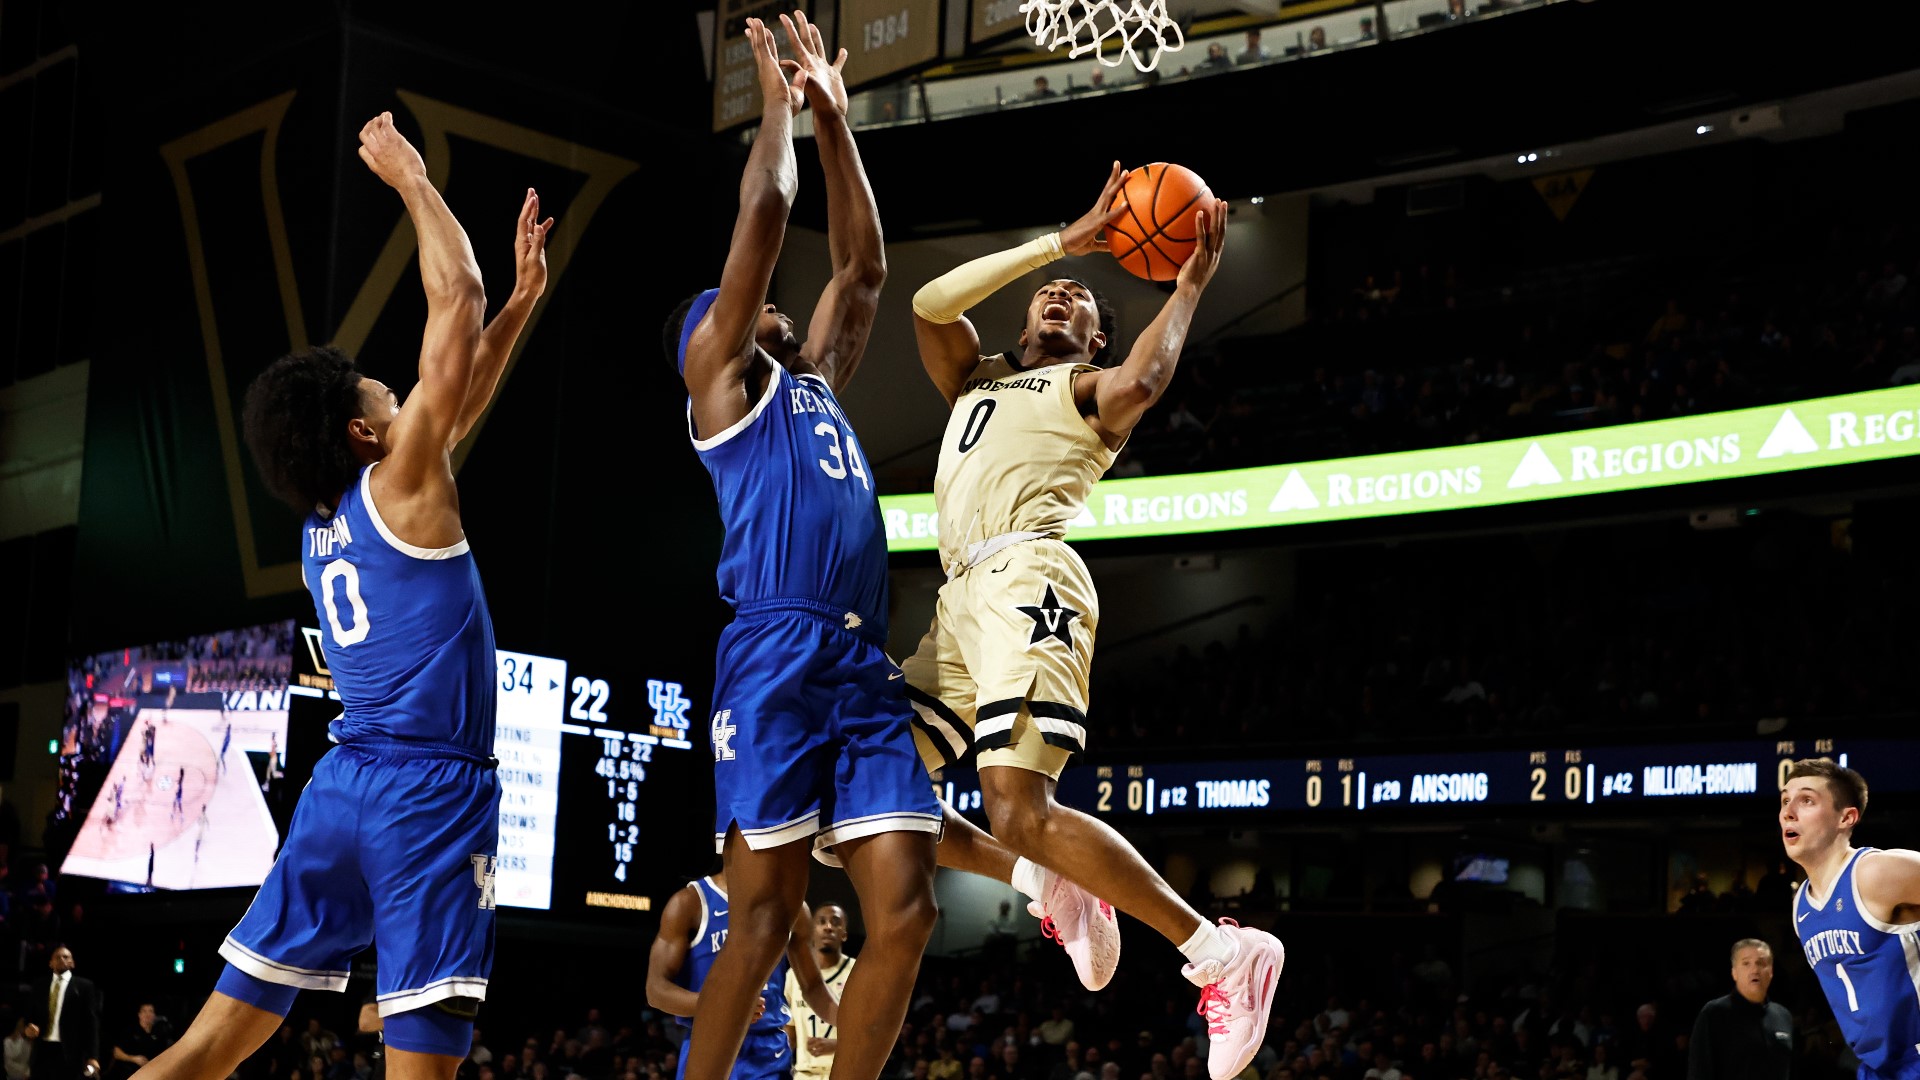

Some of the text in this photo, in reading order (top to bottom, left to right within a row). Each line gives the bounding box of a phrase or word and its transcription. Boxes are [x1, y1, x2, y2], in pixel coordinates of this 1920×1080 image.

[864, 9, 909, 51] 1984
[958, 398, 997, 453] 0
[814, 421, 869, 491] 34
[1570, 433, 1741, 481] REGIONS
[1326, 465, 1482, 507] REGIONS
[1102, 489, 1248, 526] REGIONS
[308, 514, 353, 558] TOPIN
[320, 557, 371, 648] 0
[1040, 609, 1063, 632] V
[569, 676, 610, 723] 22
[647, 679, 691, 730] UK
[595, 758, 645, 782] 45.5%
[1530, 766, 1582, 801] 2 0
[1602, 762, 1758, 797] #42 MILLORA-BROWN
[1097, 780, 1143, 812] 2 0
[1160, 779, 1271, 809] #12 THOMAS
[1306, 774, 1352, 807] 0 1
[1372, 773, 1489, 804] #20 ANSONG
[618, 802, 636, 822] 16
[615, 843, 632, 862] 15
[614, 863, 626, 882] 4
[1835, 962, 1859, 1012] 1
